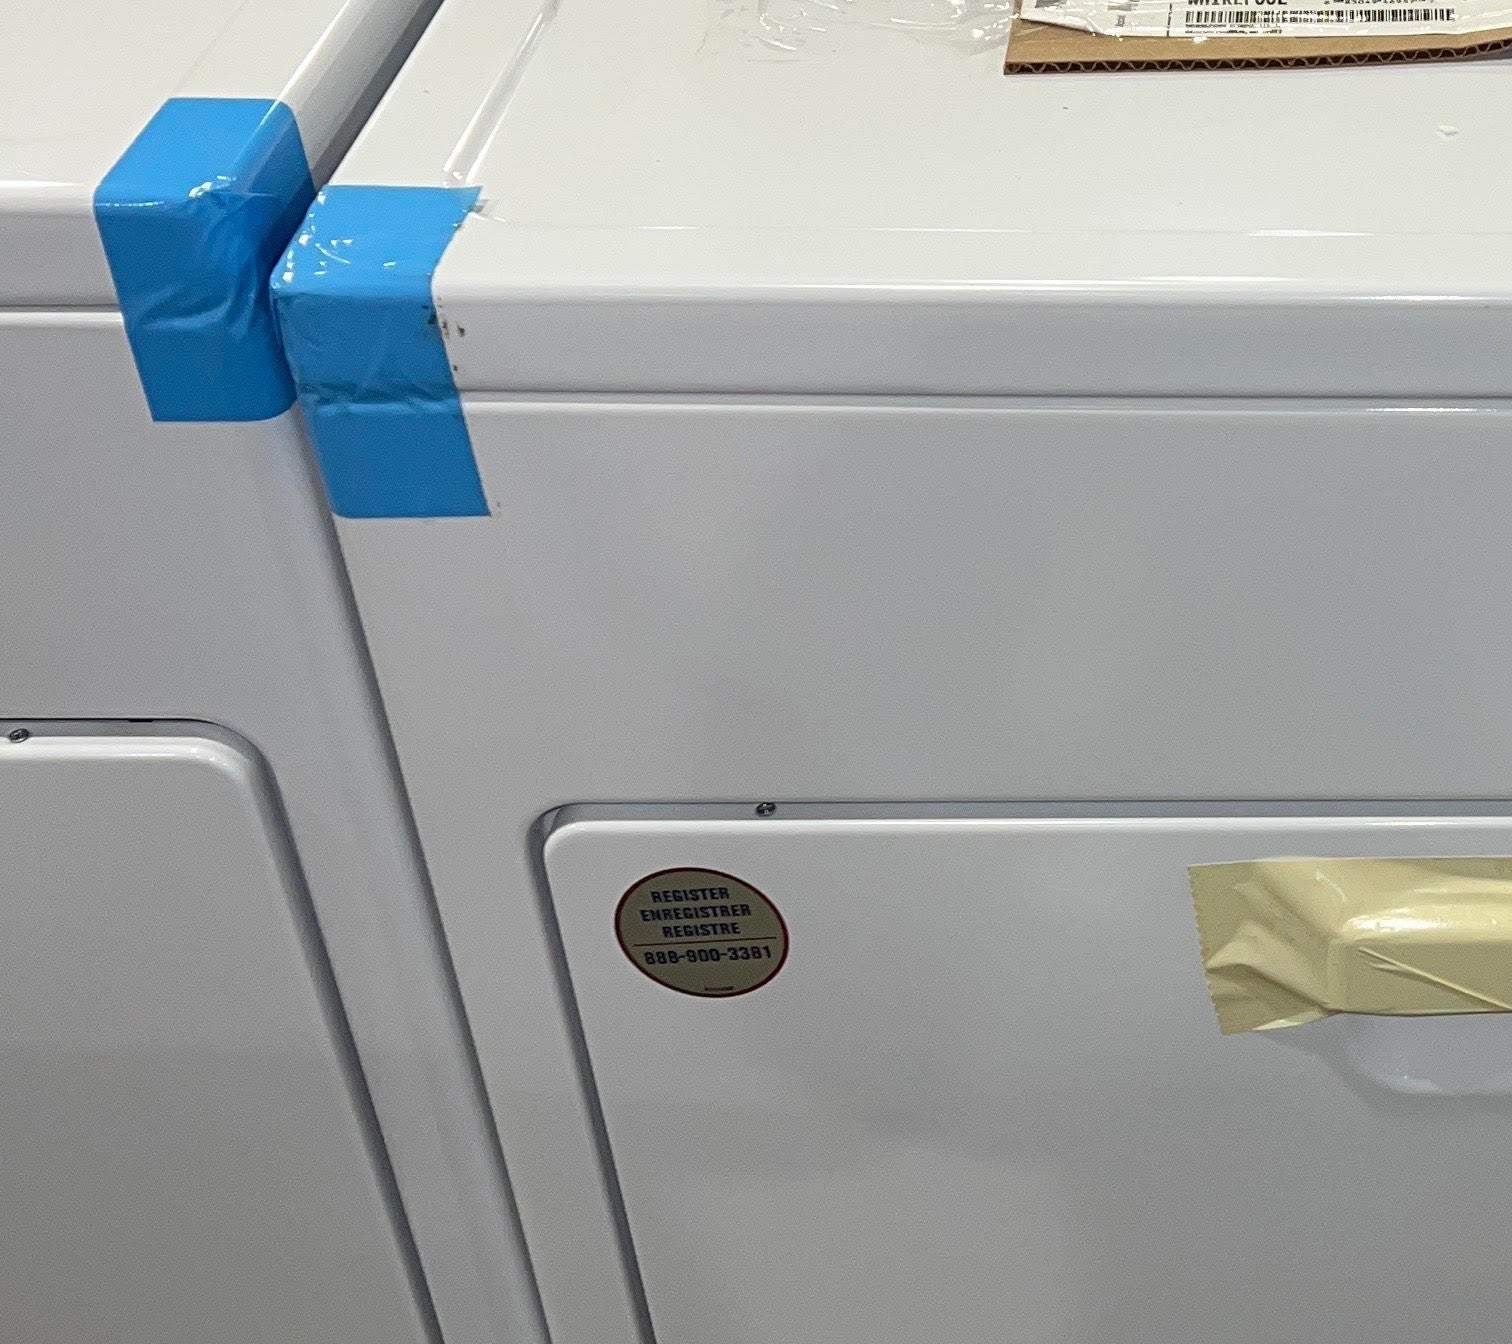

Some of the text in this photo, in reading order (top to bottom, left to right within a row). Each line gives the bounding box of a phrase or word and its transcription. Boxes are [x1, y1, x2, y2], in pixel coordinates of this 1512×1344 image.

[651, 887, 730, 903] REGISTER
[640, 904, 752, 922] ENREGISTRER
[662, 923, 741, 939] REGISTRE
